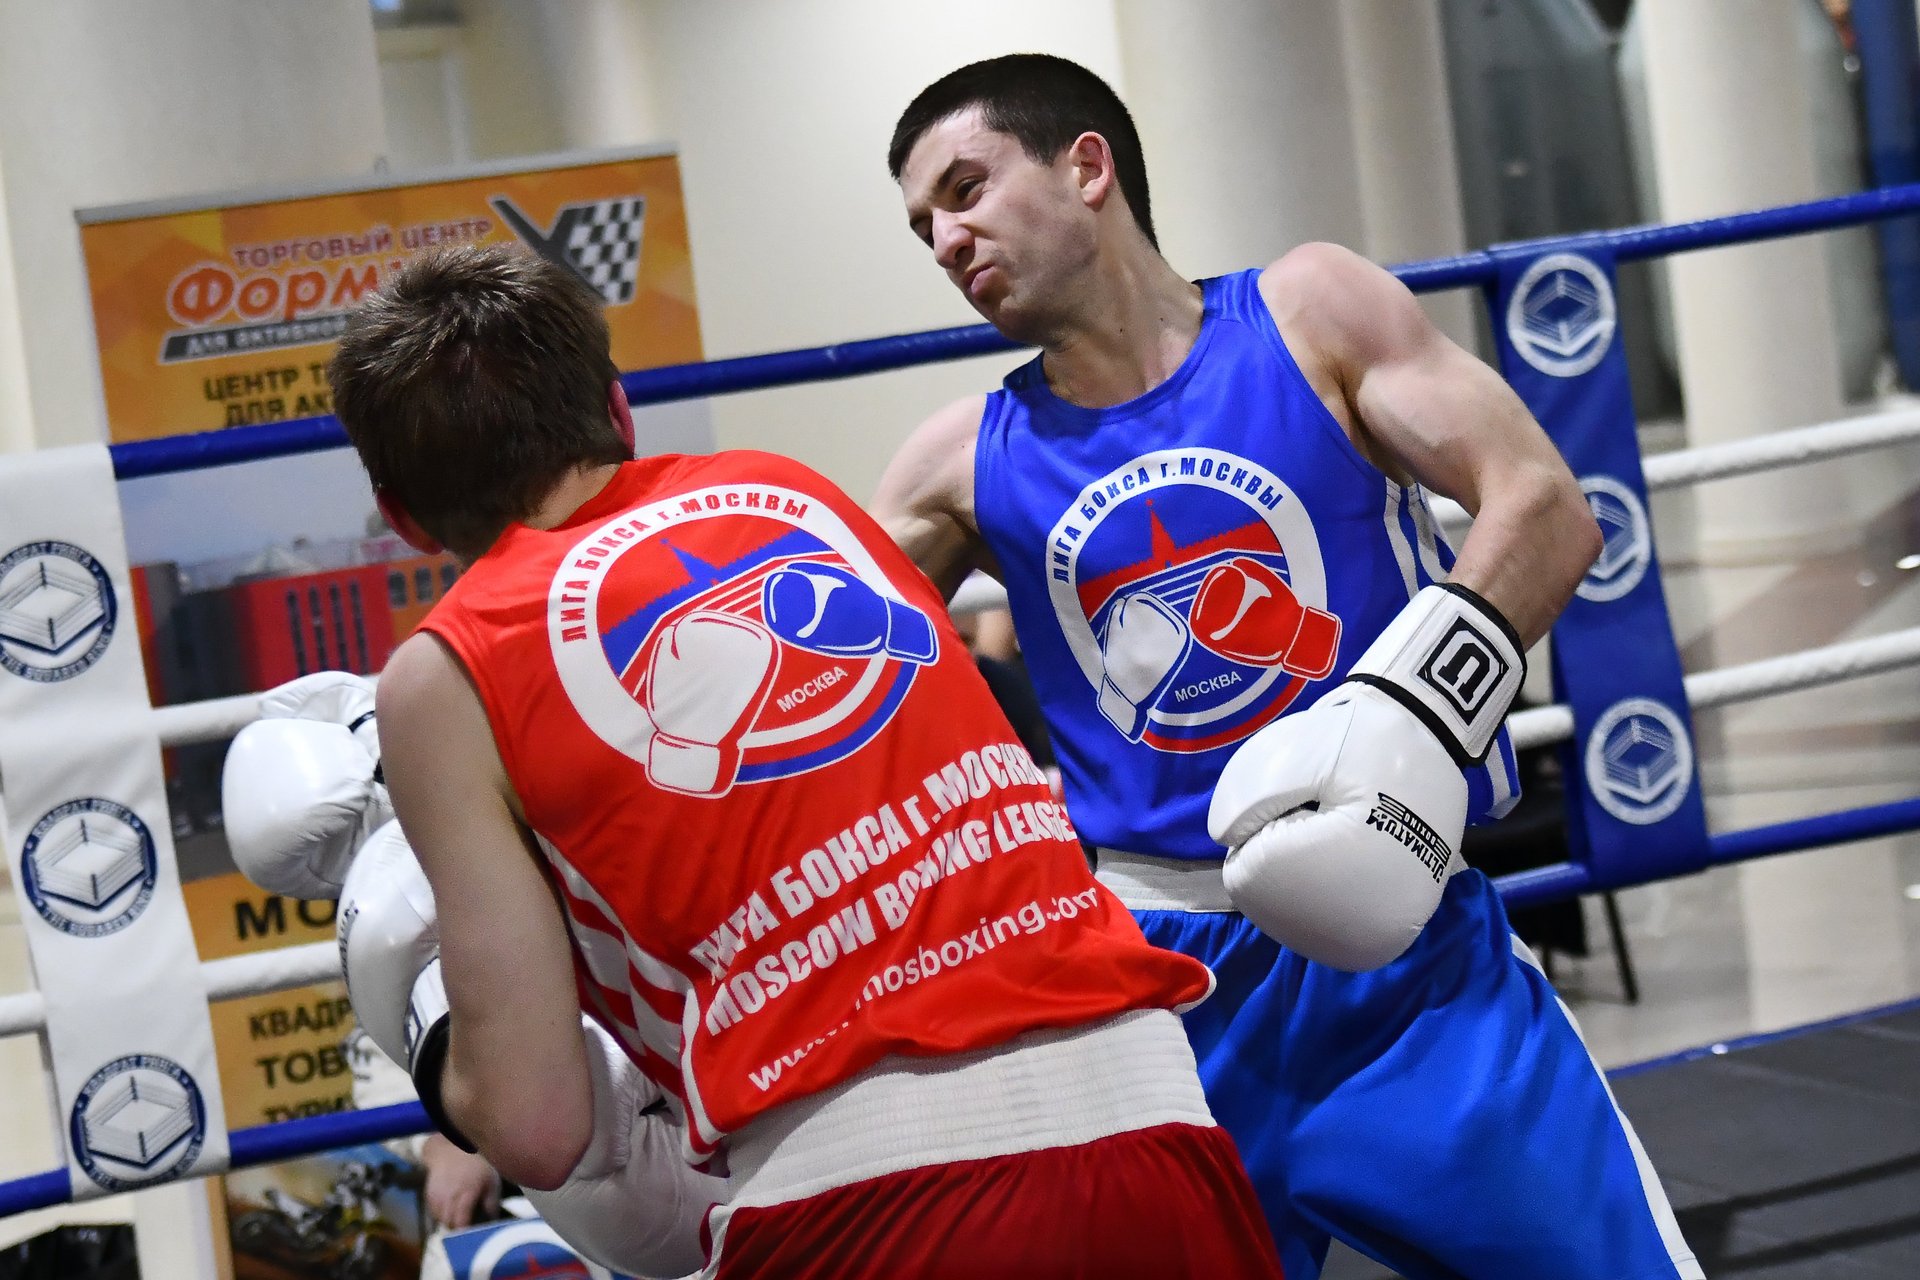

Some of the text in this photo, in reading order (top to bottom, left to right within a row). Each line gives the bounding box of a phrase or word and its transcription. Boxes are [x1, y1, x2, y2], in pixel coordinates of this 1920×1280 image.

[233, 219, 493, 268] ТОРГОВЫЙ ЦЕНТР
[171, 258, 402, 323] Форм
[204, 366, 299, 401] ЦЕНТР
[1052, 523, 1081, 584] ЛИГА
[1080, 467, 1150, 522] БОКСА
[560, 579, 589, 643] ЛИГА
[576, 519, 650, 569] БОКСА
[776, 665, 848, 713] МОСКВА
[1174, 671, 1243, 702] МОСКВА
[1366, 808, 1444, 884] ULTIMATUM
[1403, 812, 1437, 846] BOXING
[770, 803, 909, 918] БОКСА
[235, 895, 337, 940] МО
[706, 897, 876, 1036] MOSCOW
[873, 820, 992, 930] BOXING
[249, 997, 351, 1041] КВАДР
[257, 1044, 349, 1089] ТОВ
